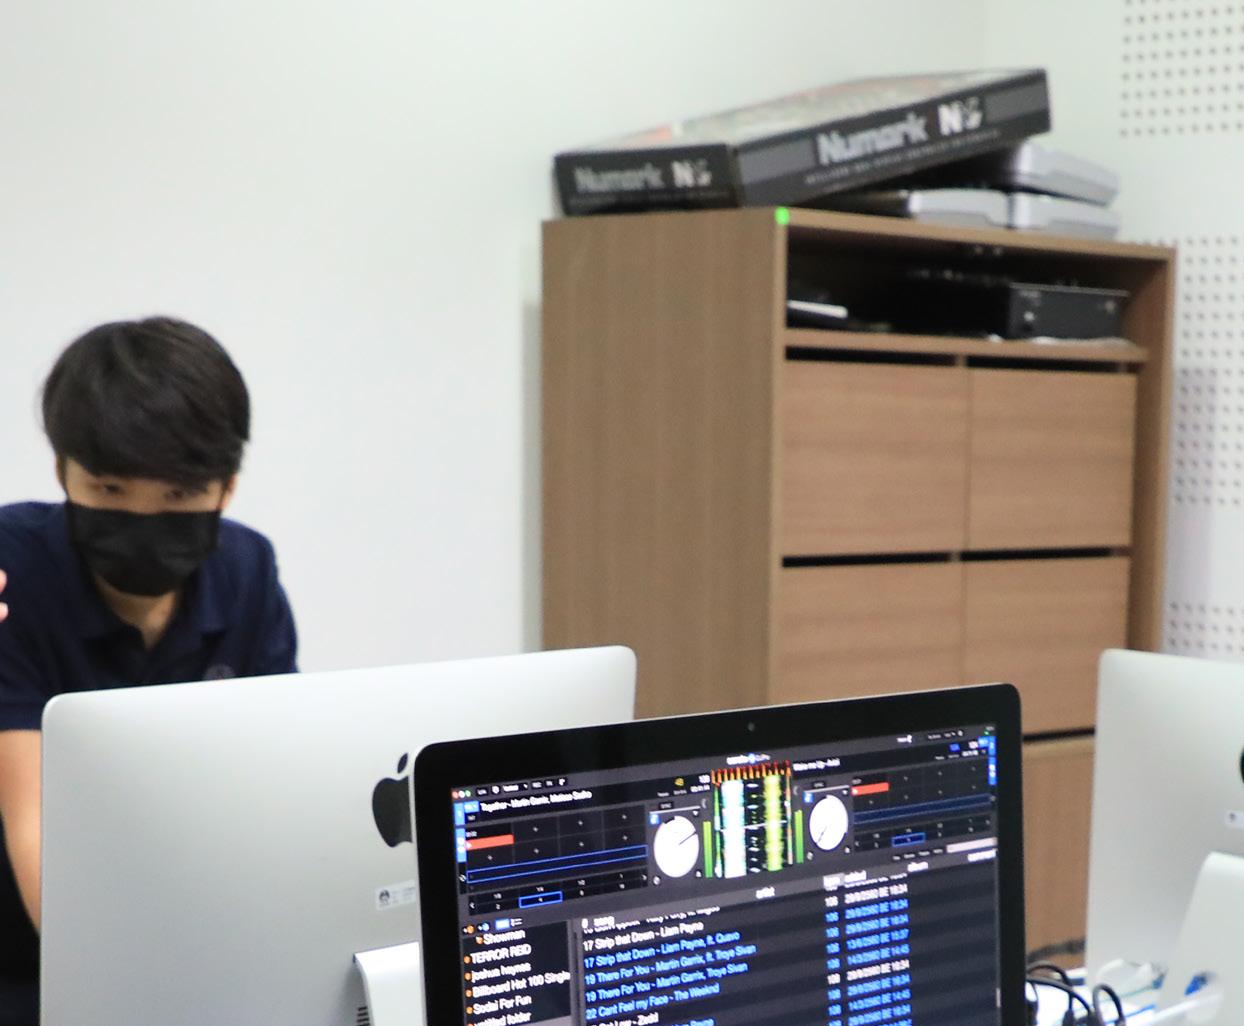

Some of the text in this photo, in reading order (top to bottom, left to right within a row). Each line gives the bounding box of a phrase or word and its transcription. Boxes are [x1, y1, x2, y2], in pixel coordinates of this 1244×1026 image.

[816, 111, 928, 166] Numark
[630, 930, 655, 943] Down
[631, 947, 655, 960] Down
